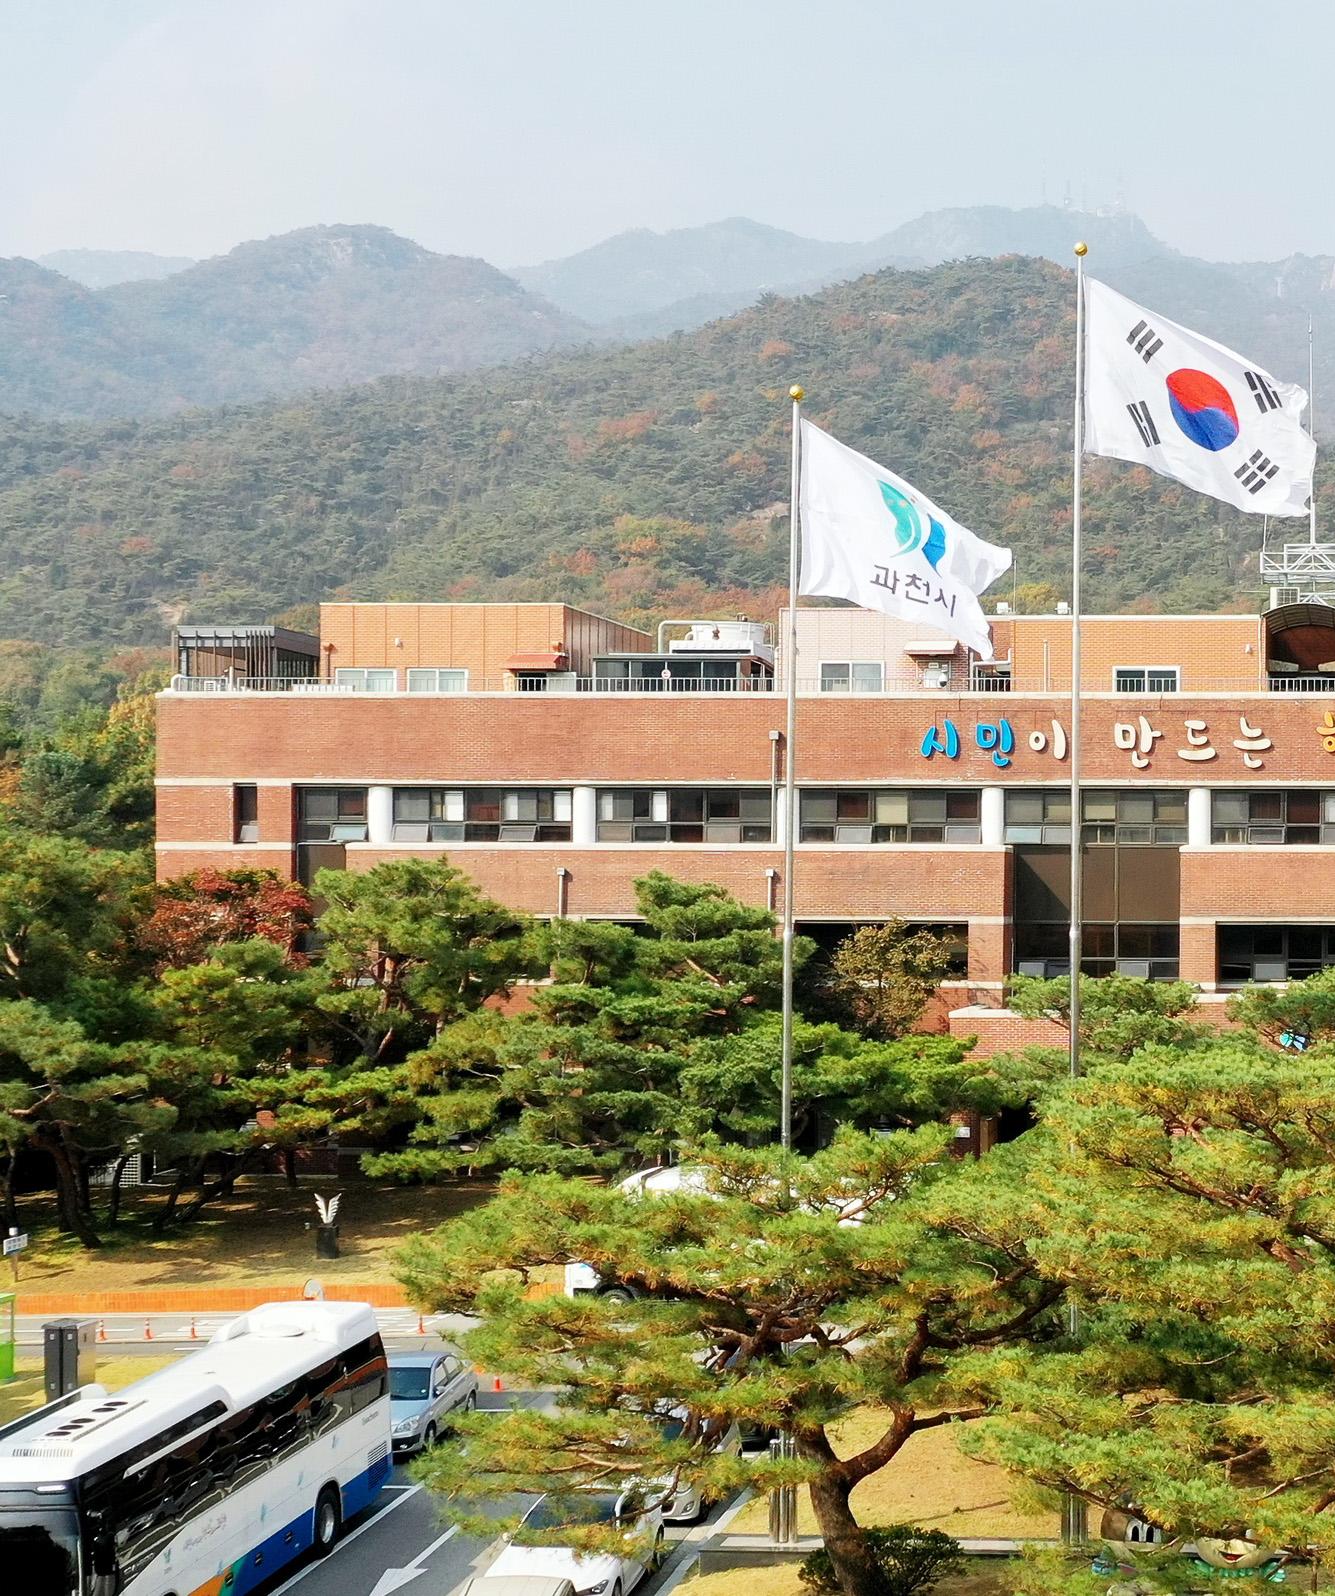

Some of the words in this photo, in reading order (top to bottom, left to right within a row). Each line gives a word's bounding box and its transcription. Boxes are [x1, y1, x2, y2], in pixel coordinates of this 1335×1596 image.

[870, 564, 956, 618] 과천시
[920, 718, 1067, 769] 시민이
[1113, 715, 1273, 769] 만드는
